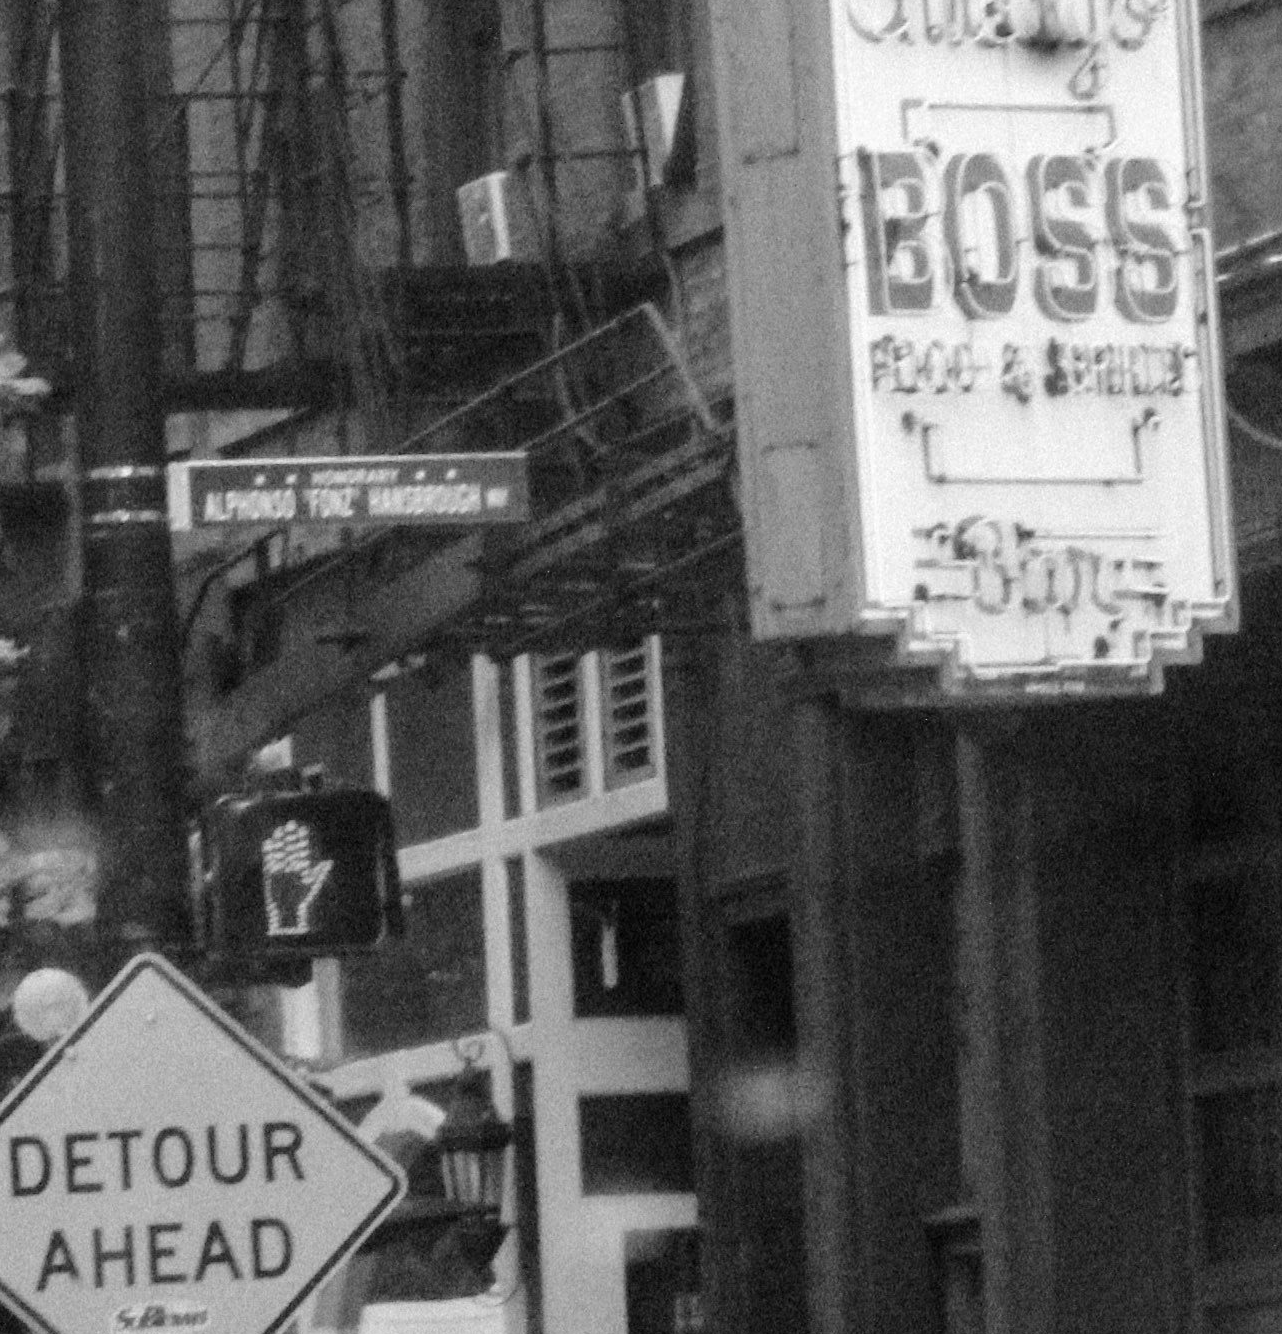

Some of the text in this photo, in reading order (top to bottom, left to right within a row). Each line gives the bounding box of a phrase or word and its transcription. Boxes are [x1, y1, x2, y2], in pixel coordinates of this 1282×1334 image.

[858, 149, 1181, 324] BOSS
[10, 1121, 306, 1198] DETOUR
[37, 1218, 294, 1292] AHEAD
